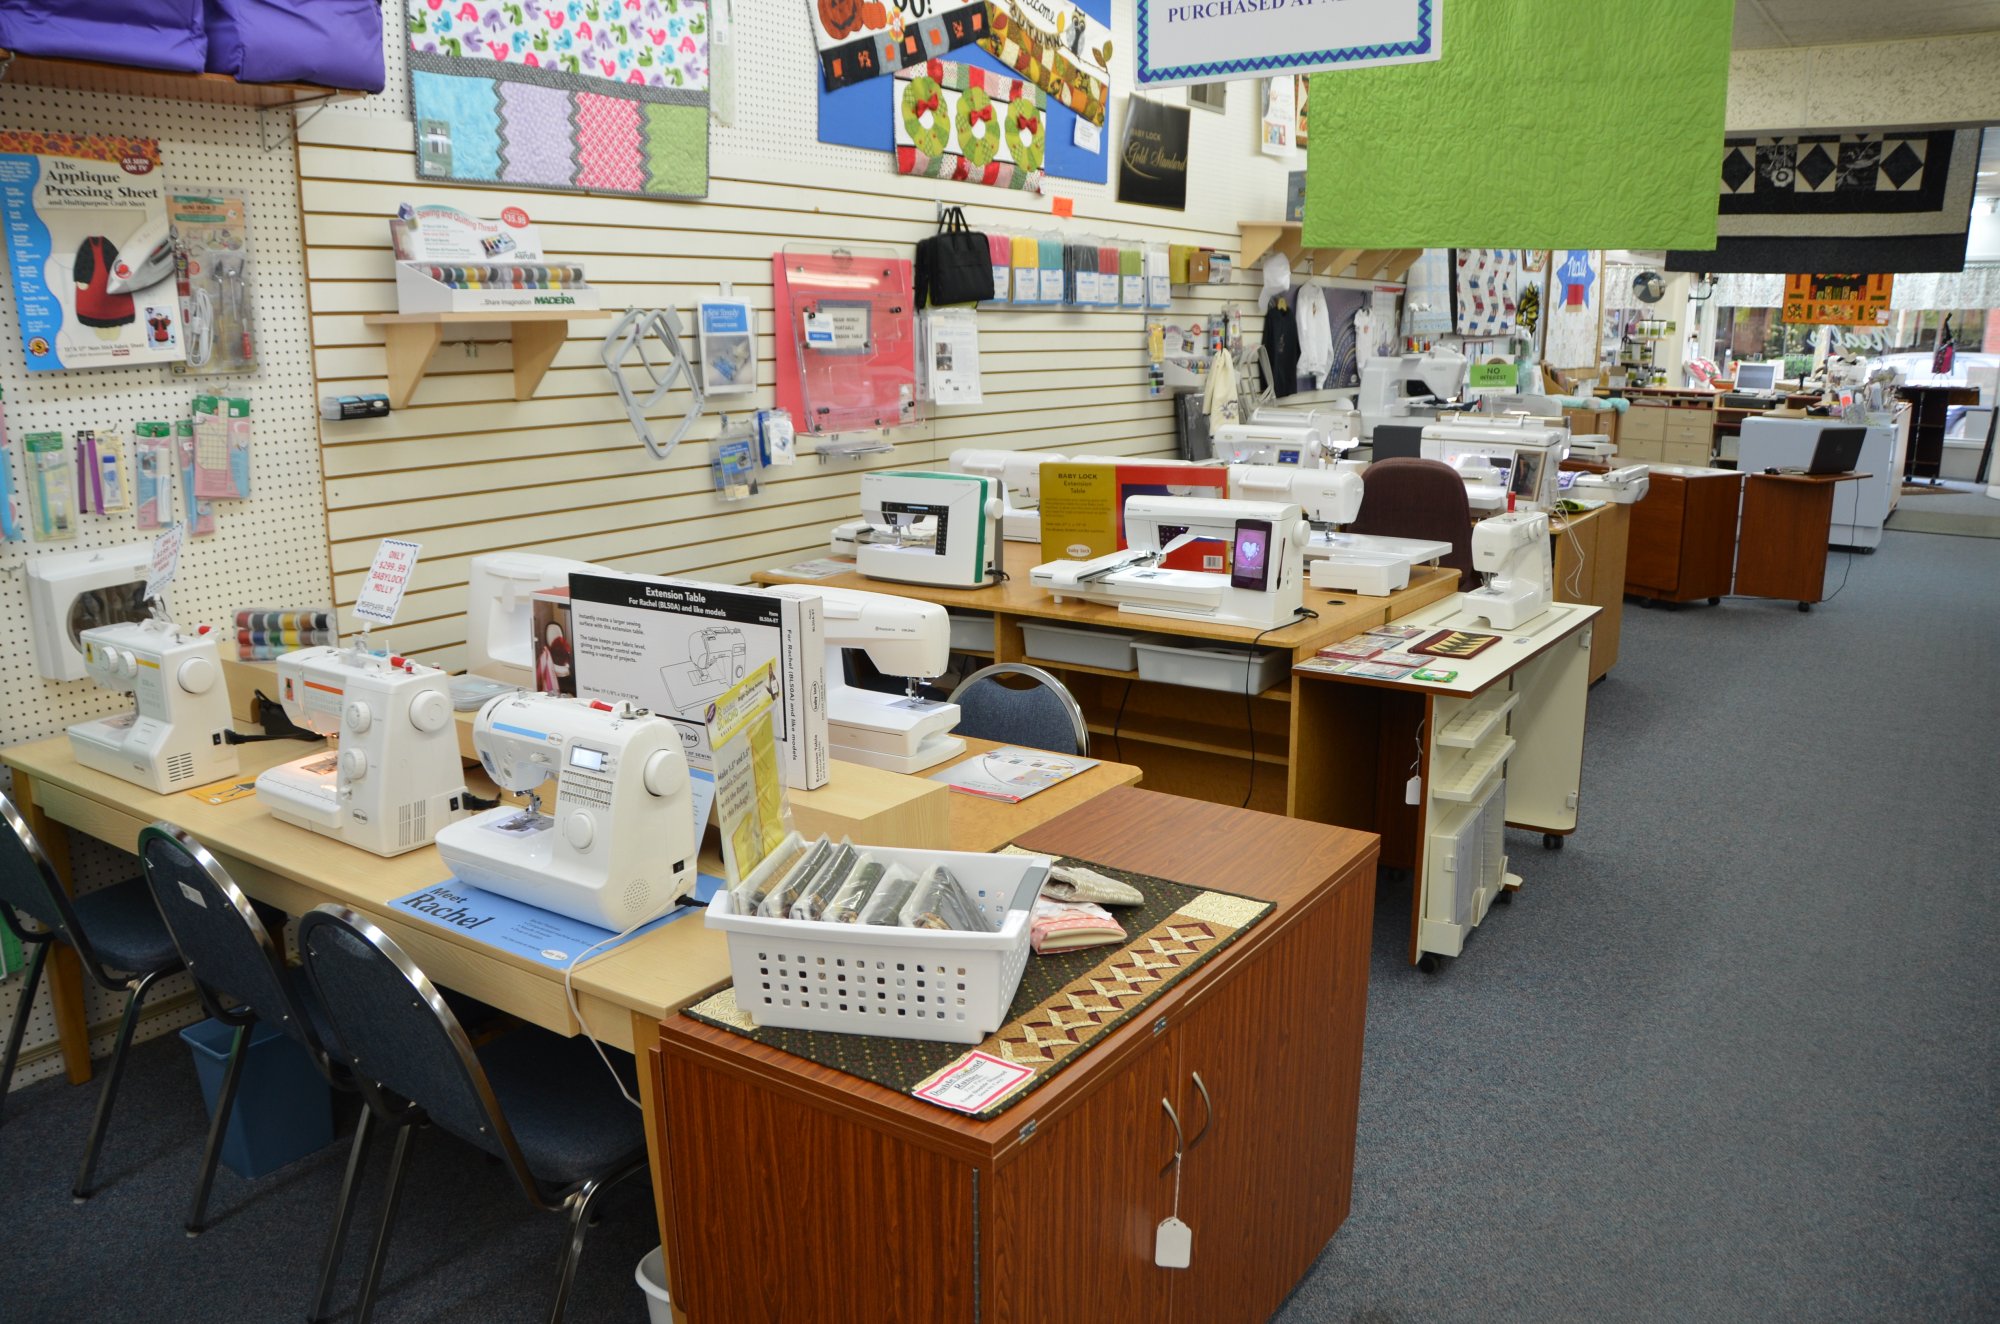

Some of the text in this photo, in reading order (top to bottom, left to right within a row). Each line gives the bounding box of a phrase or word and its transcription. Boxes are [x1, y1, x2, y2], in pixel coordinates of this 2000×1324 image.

[1022, 0, 1056, 25] come
[1168, 0, 1284, 22] PURCHASED
[1009, 3, 1064, 48] AUTUMN
[1146, 131, 1160, 140] LOCK
[1129, 142, 1187, 171] Gold Standard
[52, 161, 76, 170] The
[46, 171, 120, 184] Applique
[45, 185, 159, 199] Pressing Sheet
[417, 210, 440, 219] Sewing
[441, 210, 452, 220] and
[453, 213, 477, 231] Quilting
[477, 222, 498, 232] Thread
[534, 294, 575, 305] MADEIRA
[389, 551, 405, 560] ONLY
[379, 561, 406, 572] $299.99
[372, 571, 404, 584] BABYLOCK
[374, 583, 394, 593] MOLLY
[646, 587, 706, 603] Extension Table
[628, 597, 638, 605] For
[639, 599, 657, 608] Rachel
[658, 601, 680, 611] (BL50A)
[705, 608, 726, 617] models
[599, 637, 611, 645] keeps
[599, 652, 613, 660] variety
[788, 671, 796, 701] (BL50A)
[685, 732, 698, 741] lock
[718, 770, 729, 781] Make
[429, 887, 467, 904] Meet
[402, 893, 496, 930] Rachel
[930, 1078, 954, 1096] Double
